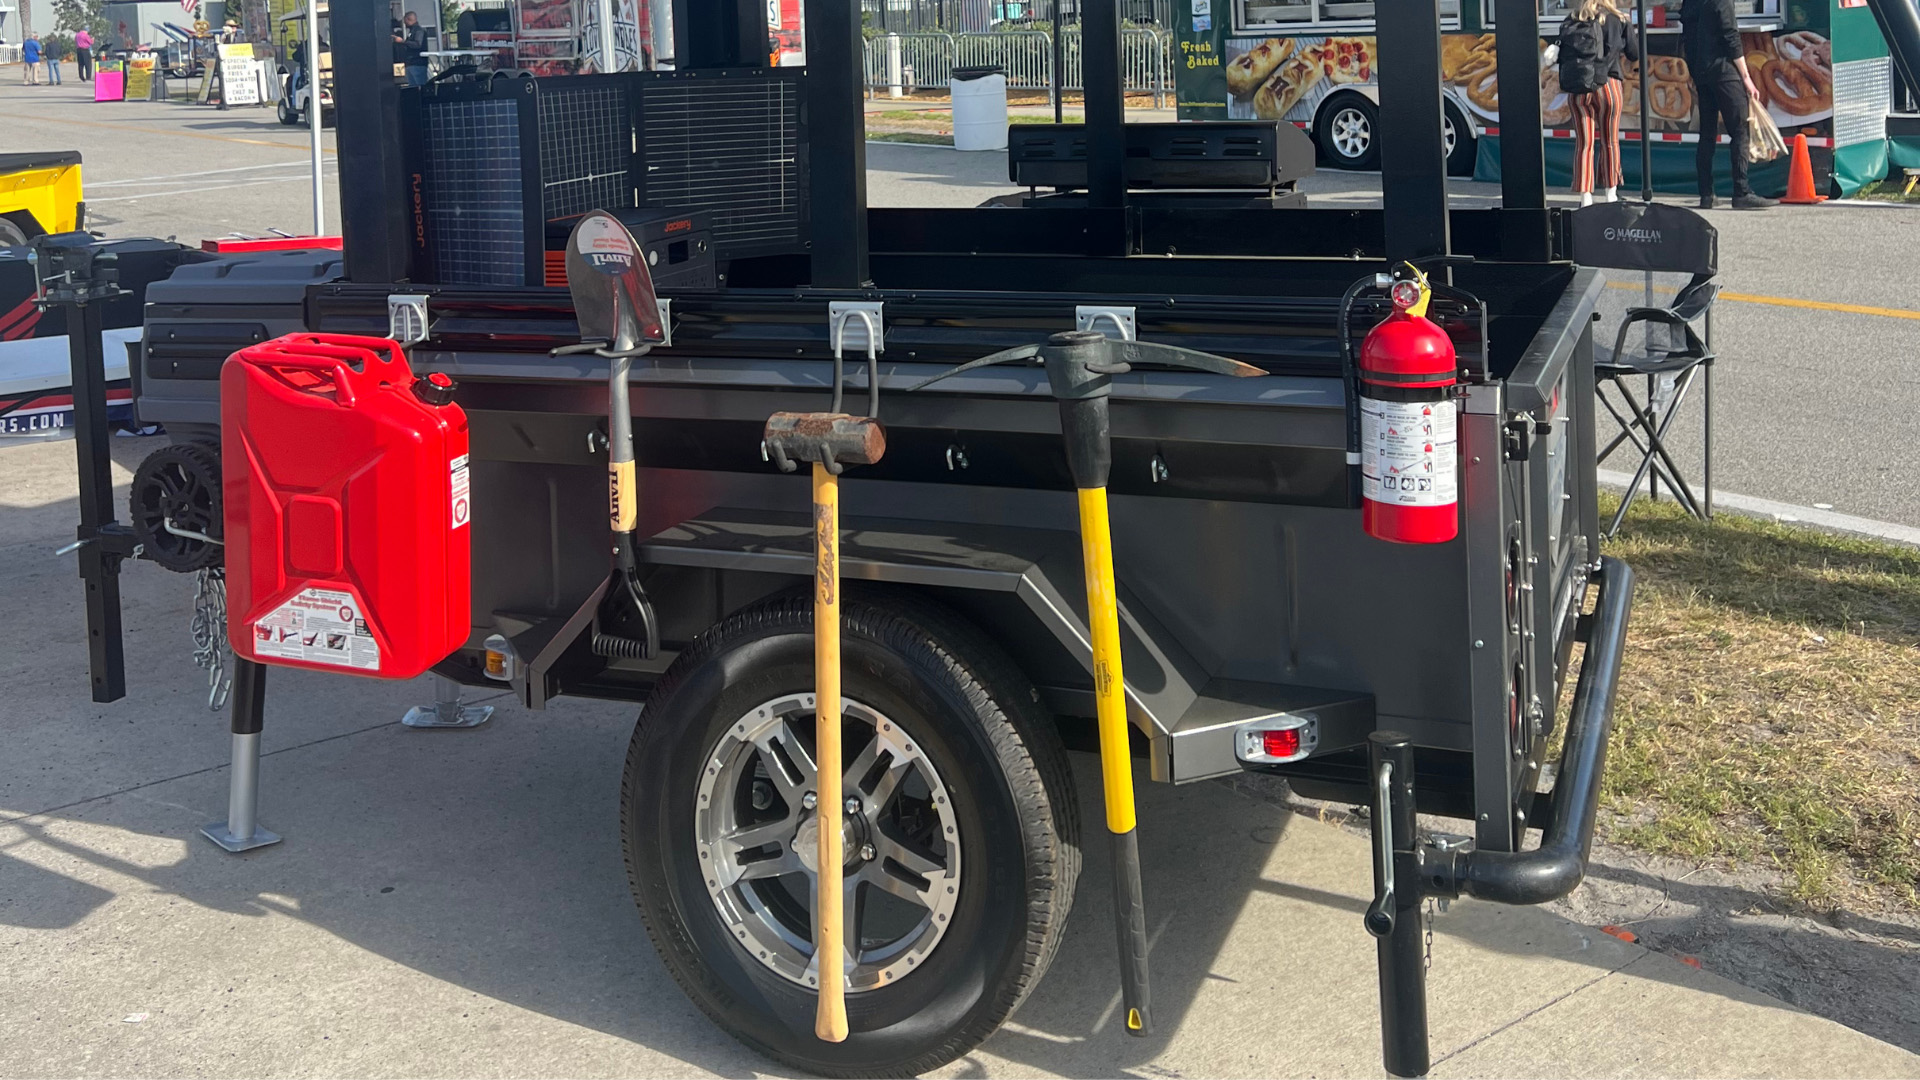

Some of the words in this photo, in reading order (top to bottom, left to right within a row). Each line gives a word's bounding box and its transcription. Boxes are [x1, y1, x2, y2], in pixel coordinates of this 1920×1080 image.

[1181, 41, 1212, 54] Fresh
[1187, 55, 1219, 69] Baked
[412, 173, 425, 248] Jackery
[664, 219, 691, 233] Jackery
[1617, 228, 1661, 239] MAGELLAN
[591, 253, 632, 268] Anvil
[609, 470, 620, 524] Anvil
